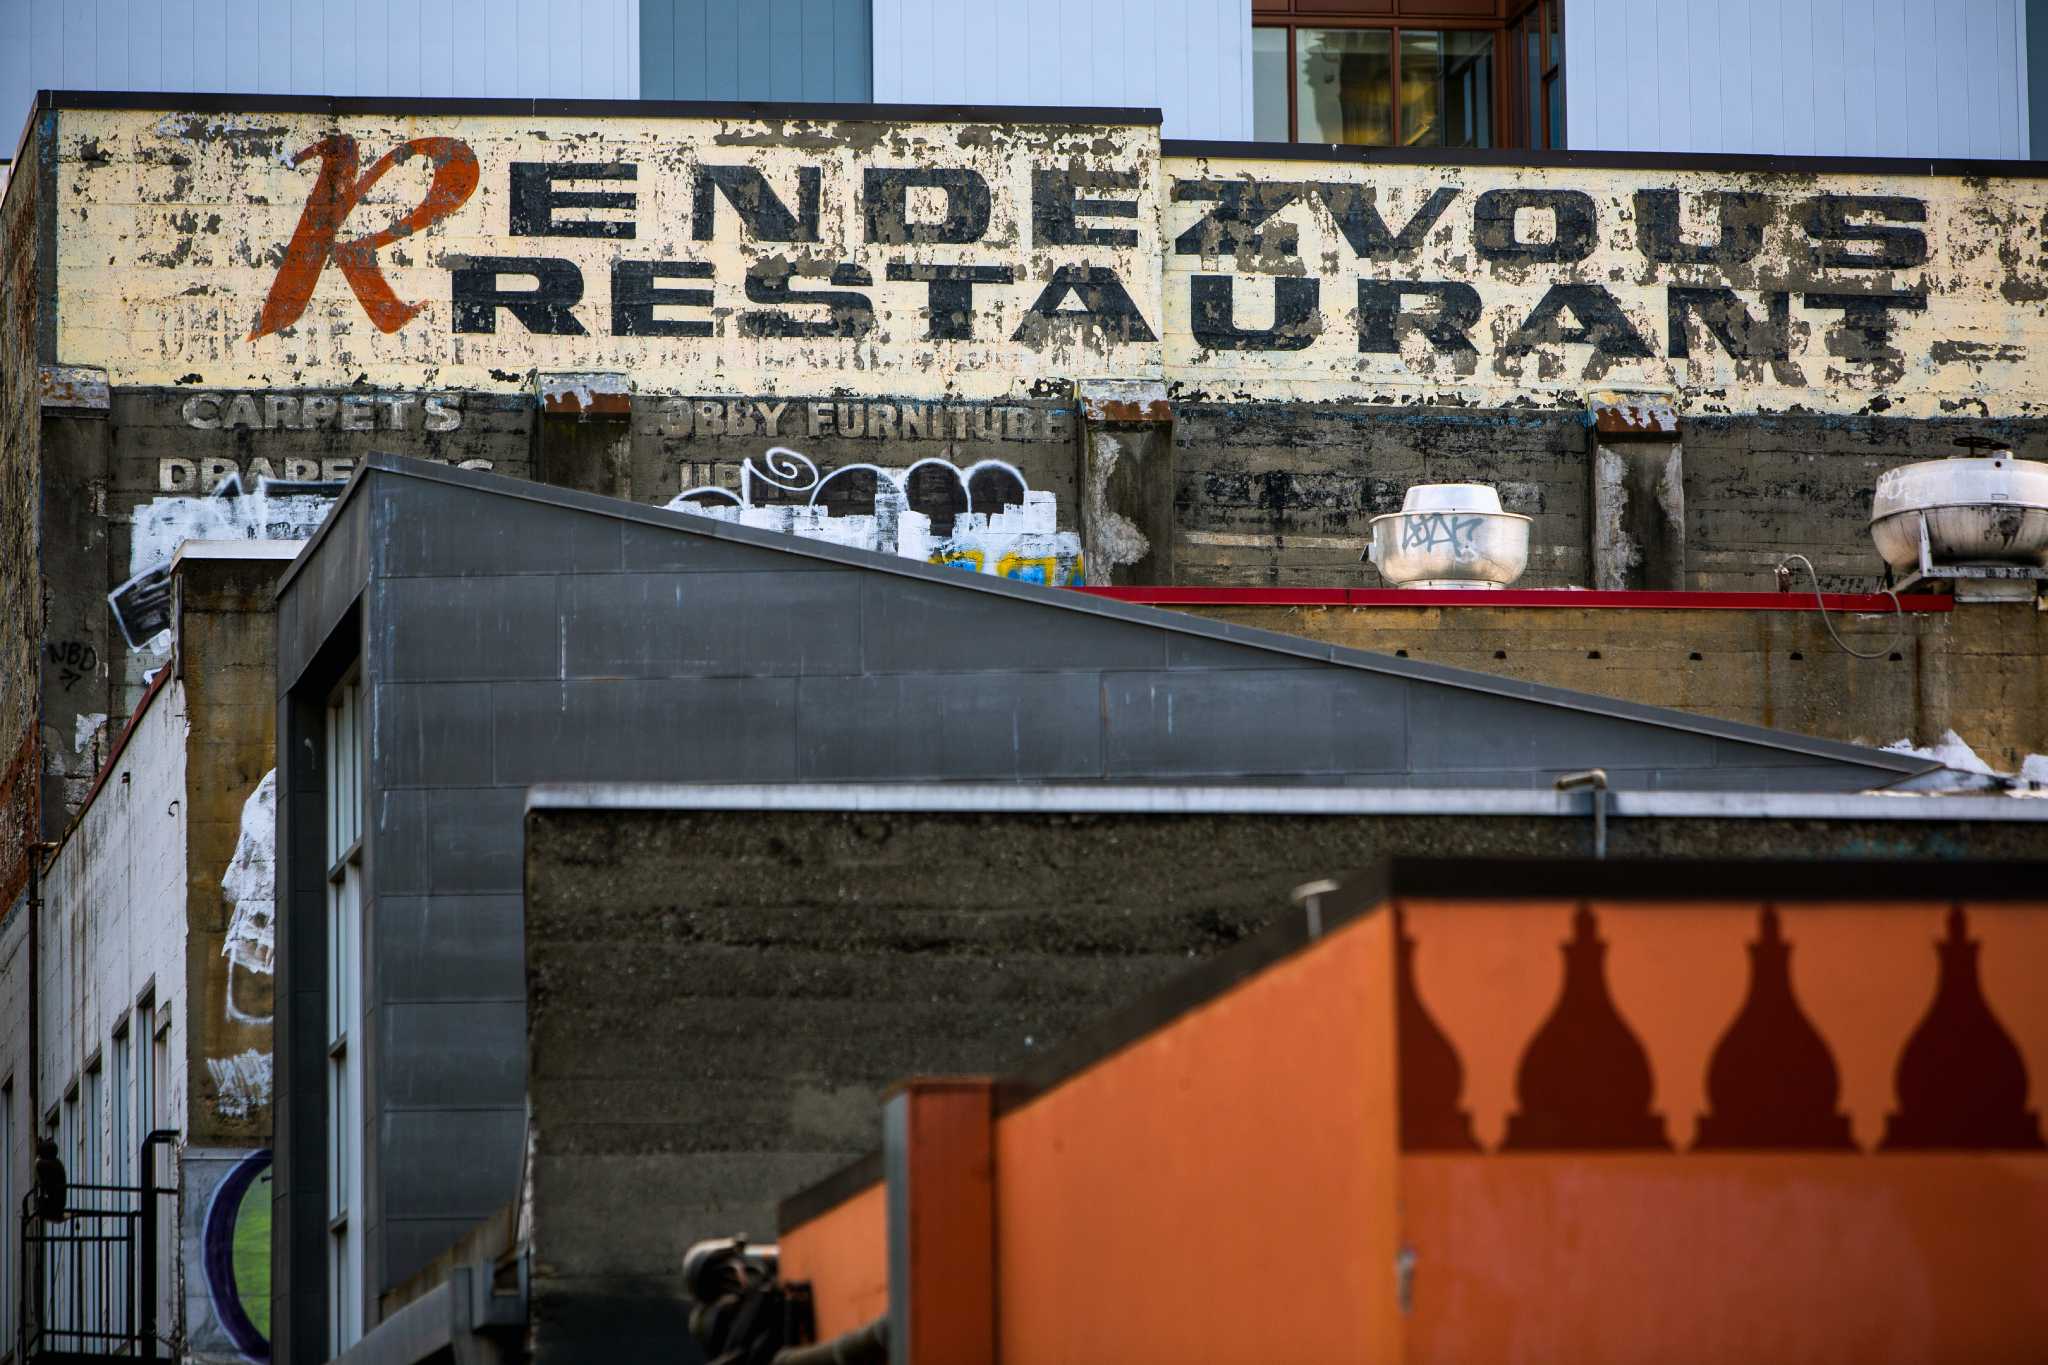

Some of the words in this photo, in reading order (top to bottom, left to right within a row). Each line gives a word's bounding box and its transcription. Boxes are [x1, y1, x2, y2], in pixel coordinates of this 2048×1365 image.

[246, 134, 1928, 341] RENDEZVOUS
[452, 256, 1927, 363] RESTAURANT
[182, 393, 462, 431] CARPETS
[655, 398, 788, 437] OBBY
